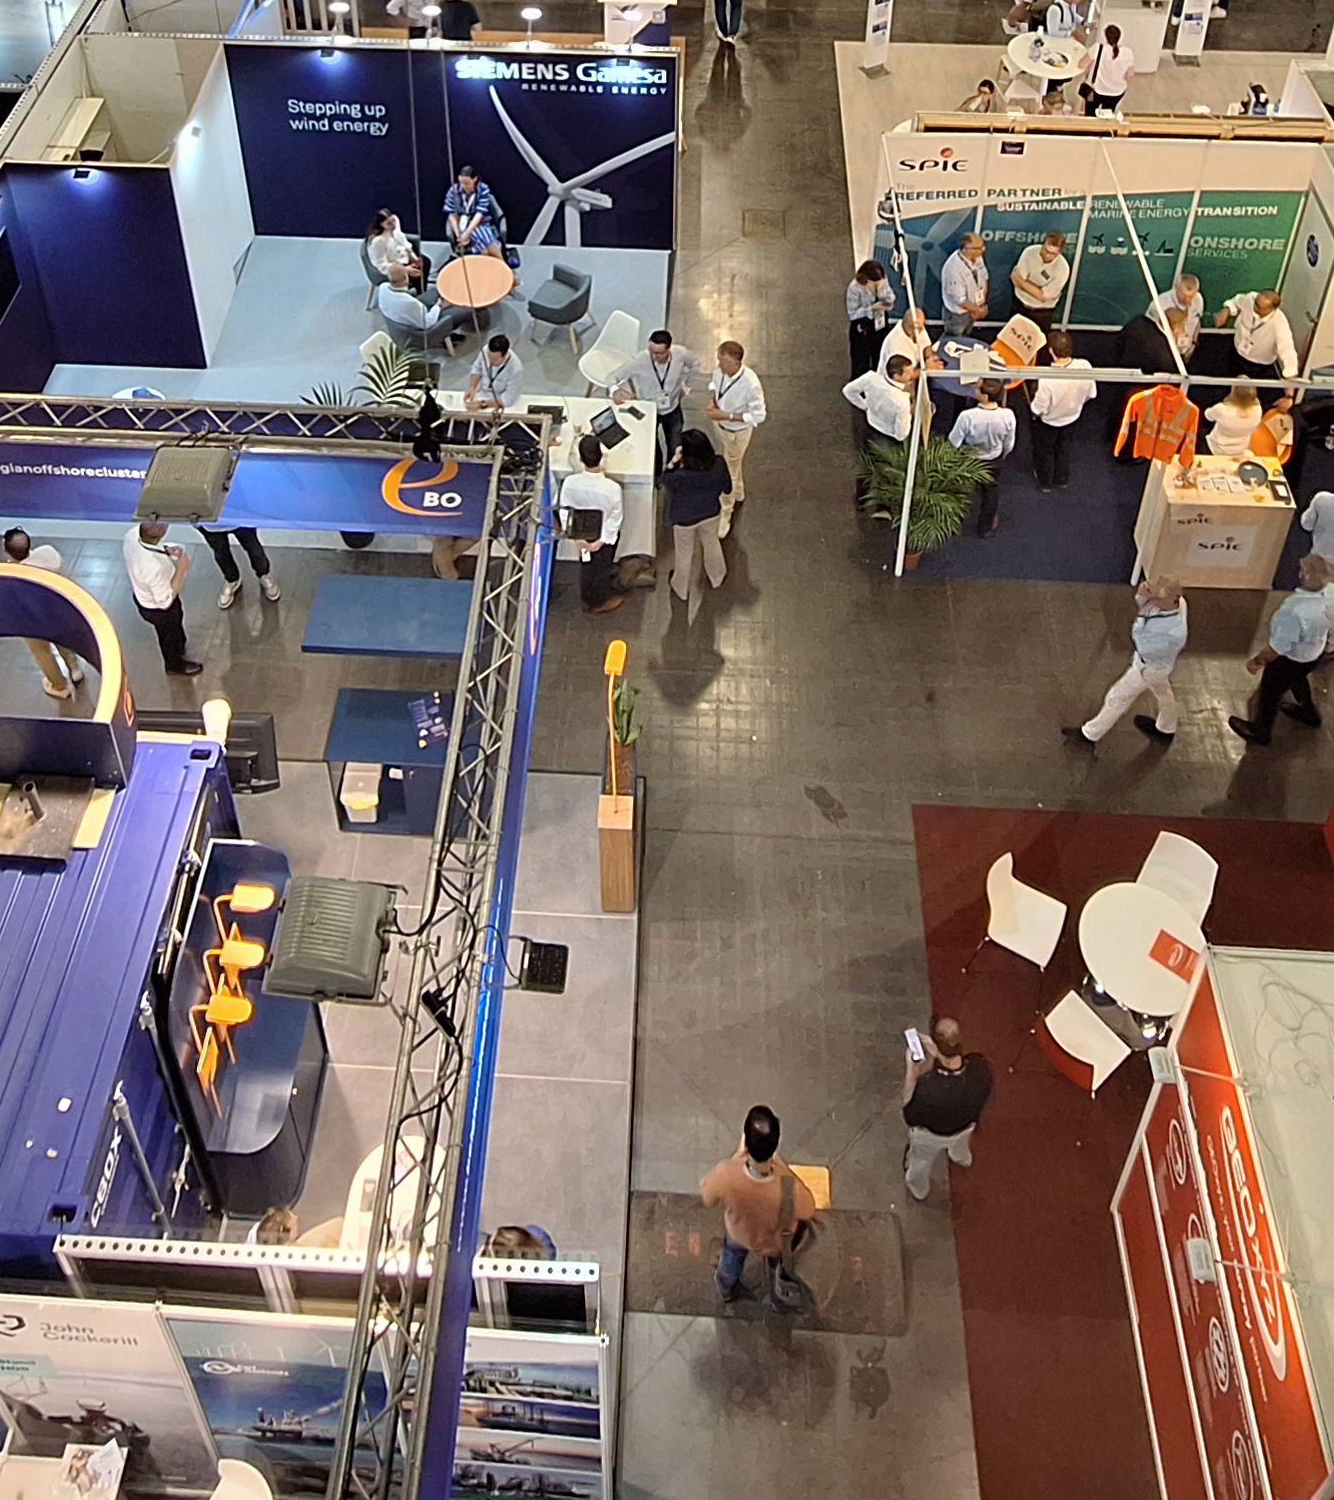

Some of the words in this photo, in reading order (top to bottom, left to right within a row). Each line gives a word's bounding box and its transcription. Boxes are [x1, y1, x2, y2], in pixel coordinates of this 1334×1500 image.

[455, 58, 569, 81] SIEMENS
[576, 61, 667, 84] Gamesa
[521, 83, 604, 93] RENEWABLE
[612, 86, 668, 96] ENERGY
[287, 98, 361, 118] Stepping
[365, 104, 386, 119] up
[289, 117, 329, 132] wind
[333, 122, 390, 137] energy
[986, 187, 1063, 199] PARTNER
[996, 201, 1085, 212] SUSTAINABLE
[1090, 199, 1165, 210] RENEWABLE
[1088, 209, 1136, 220] MARINE
[1139, 208, 1190, 219] ENERGY
[1196, 205, 1279, 216] TRANSITION
[981, 230, 1078, 244] OFFSHE
[1190, 235, 1286, 251] ONSHORE
[1187, 248, 1248, 260] SERVICES
[90, 1131, 123, 1228] CBOX
[40, 1321, 95, 1335] John
[42, 1331, 139, 1346] Cockerill
